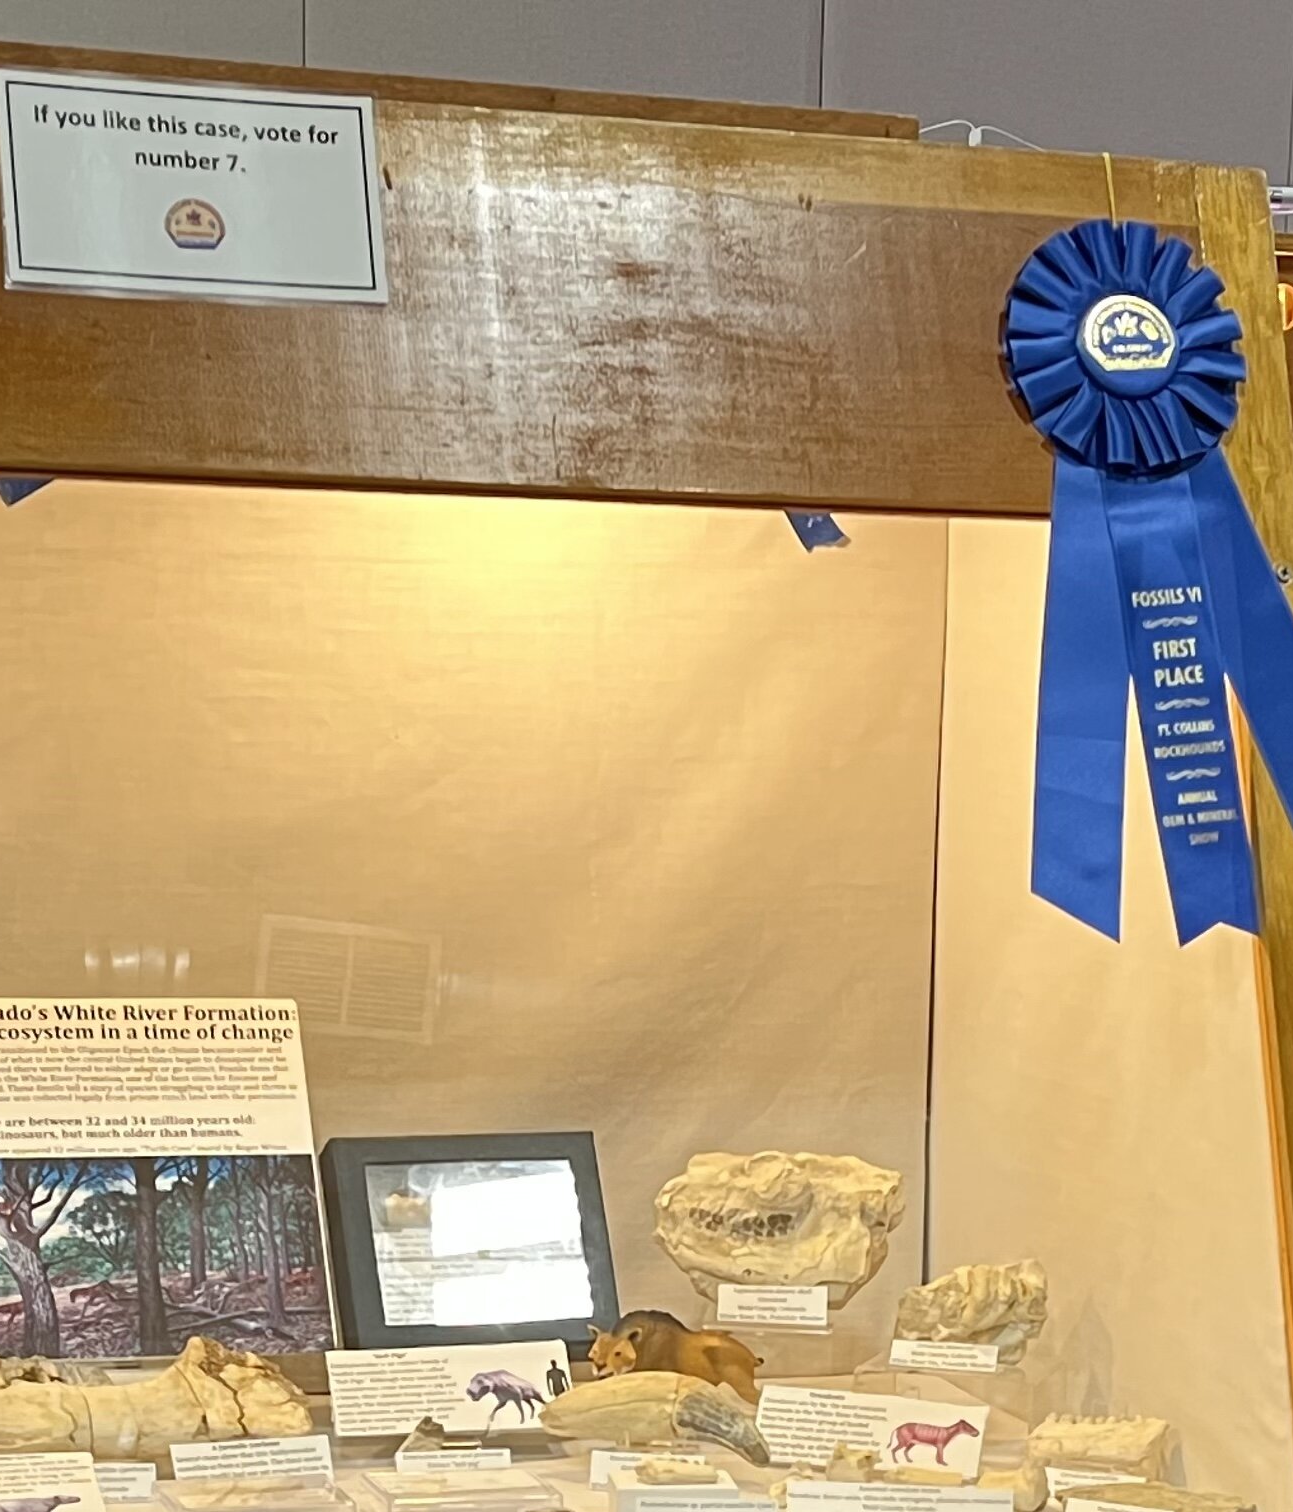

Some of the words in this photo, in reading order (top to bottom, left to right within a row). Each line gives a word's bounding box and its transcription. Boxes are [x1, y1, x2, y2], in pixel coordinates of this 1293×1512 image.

[35, 105, 47, 123] If
[55, 111, 95, 128] you
[103, 110, 140, 131] like
[148, 114, 187, 134] this
[195, 121, 247, 142] case,
[254, 126, 301, 142] vote
[309, 125, 338, 144] for
[136, 151, 219, 170] number
[227, 154, 245, 172] 7.
[1132, 588, 1185, 607] FOSSILS
[1186, 587, 1202, 602] VI
[1153, 638, 1195, 660] FIRST
[1154, 665, 1204, 687] PLACE
[1173, 720, 1214, 734] COLLINS
[54, 1005, 116, 1020] White
[123, 1005, 177, 1020] River
[184, 1006, 296, 1020] Formation:
[102, 1024, 120, 1039] in
[127, 1028, 137, 1039] a
[145, 1024, 190, 1039] time
[197, 1024, 216, 1039] of
[222, 1024, 293, 1043] change
[29, 1117, 82, 1126] between
[105, 1116, 127, 1126] and
[150, 1116, 194, 1125] million
[197, 1118, 230, 1127] years
[61, 1129, 82, 1138] but
[86, 1129, 120, 1138] much
[123, 1128, 155, 1137] older
[160, 1128, 187, 1137] than
